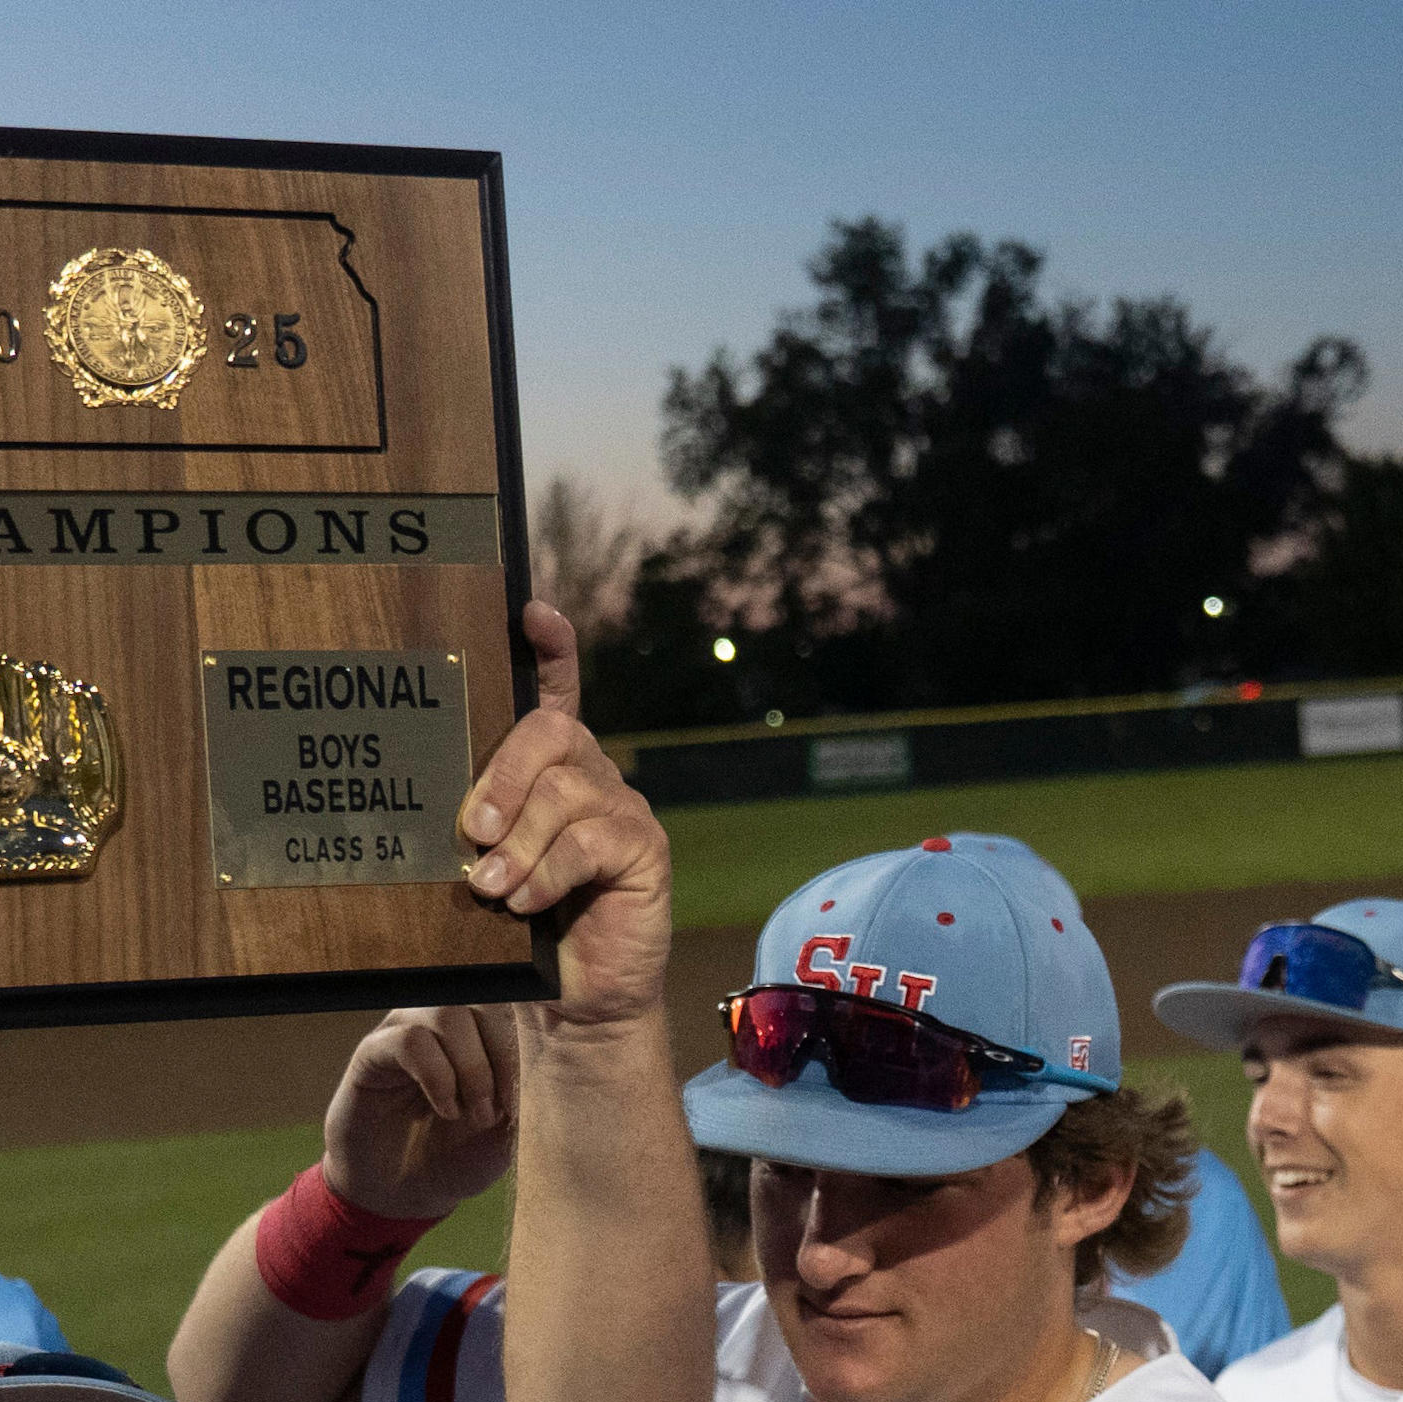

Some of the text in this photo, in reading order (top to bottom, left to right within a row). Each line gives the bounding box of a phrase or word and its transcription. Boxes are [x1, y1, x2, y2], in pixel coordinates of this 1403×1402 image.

[223, 311, 308, 369] 25
[226, 664, 441, 711] REGIONAL
[298, 733, 382, 770] BOYS
[262, 777, 424, 815] BASEBALL
[285, 836, 406, 864] CLASS 5A
